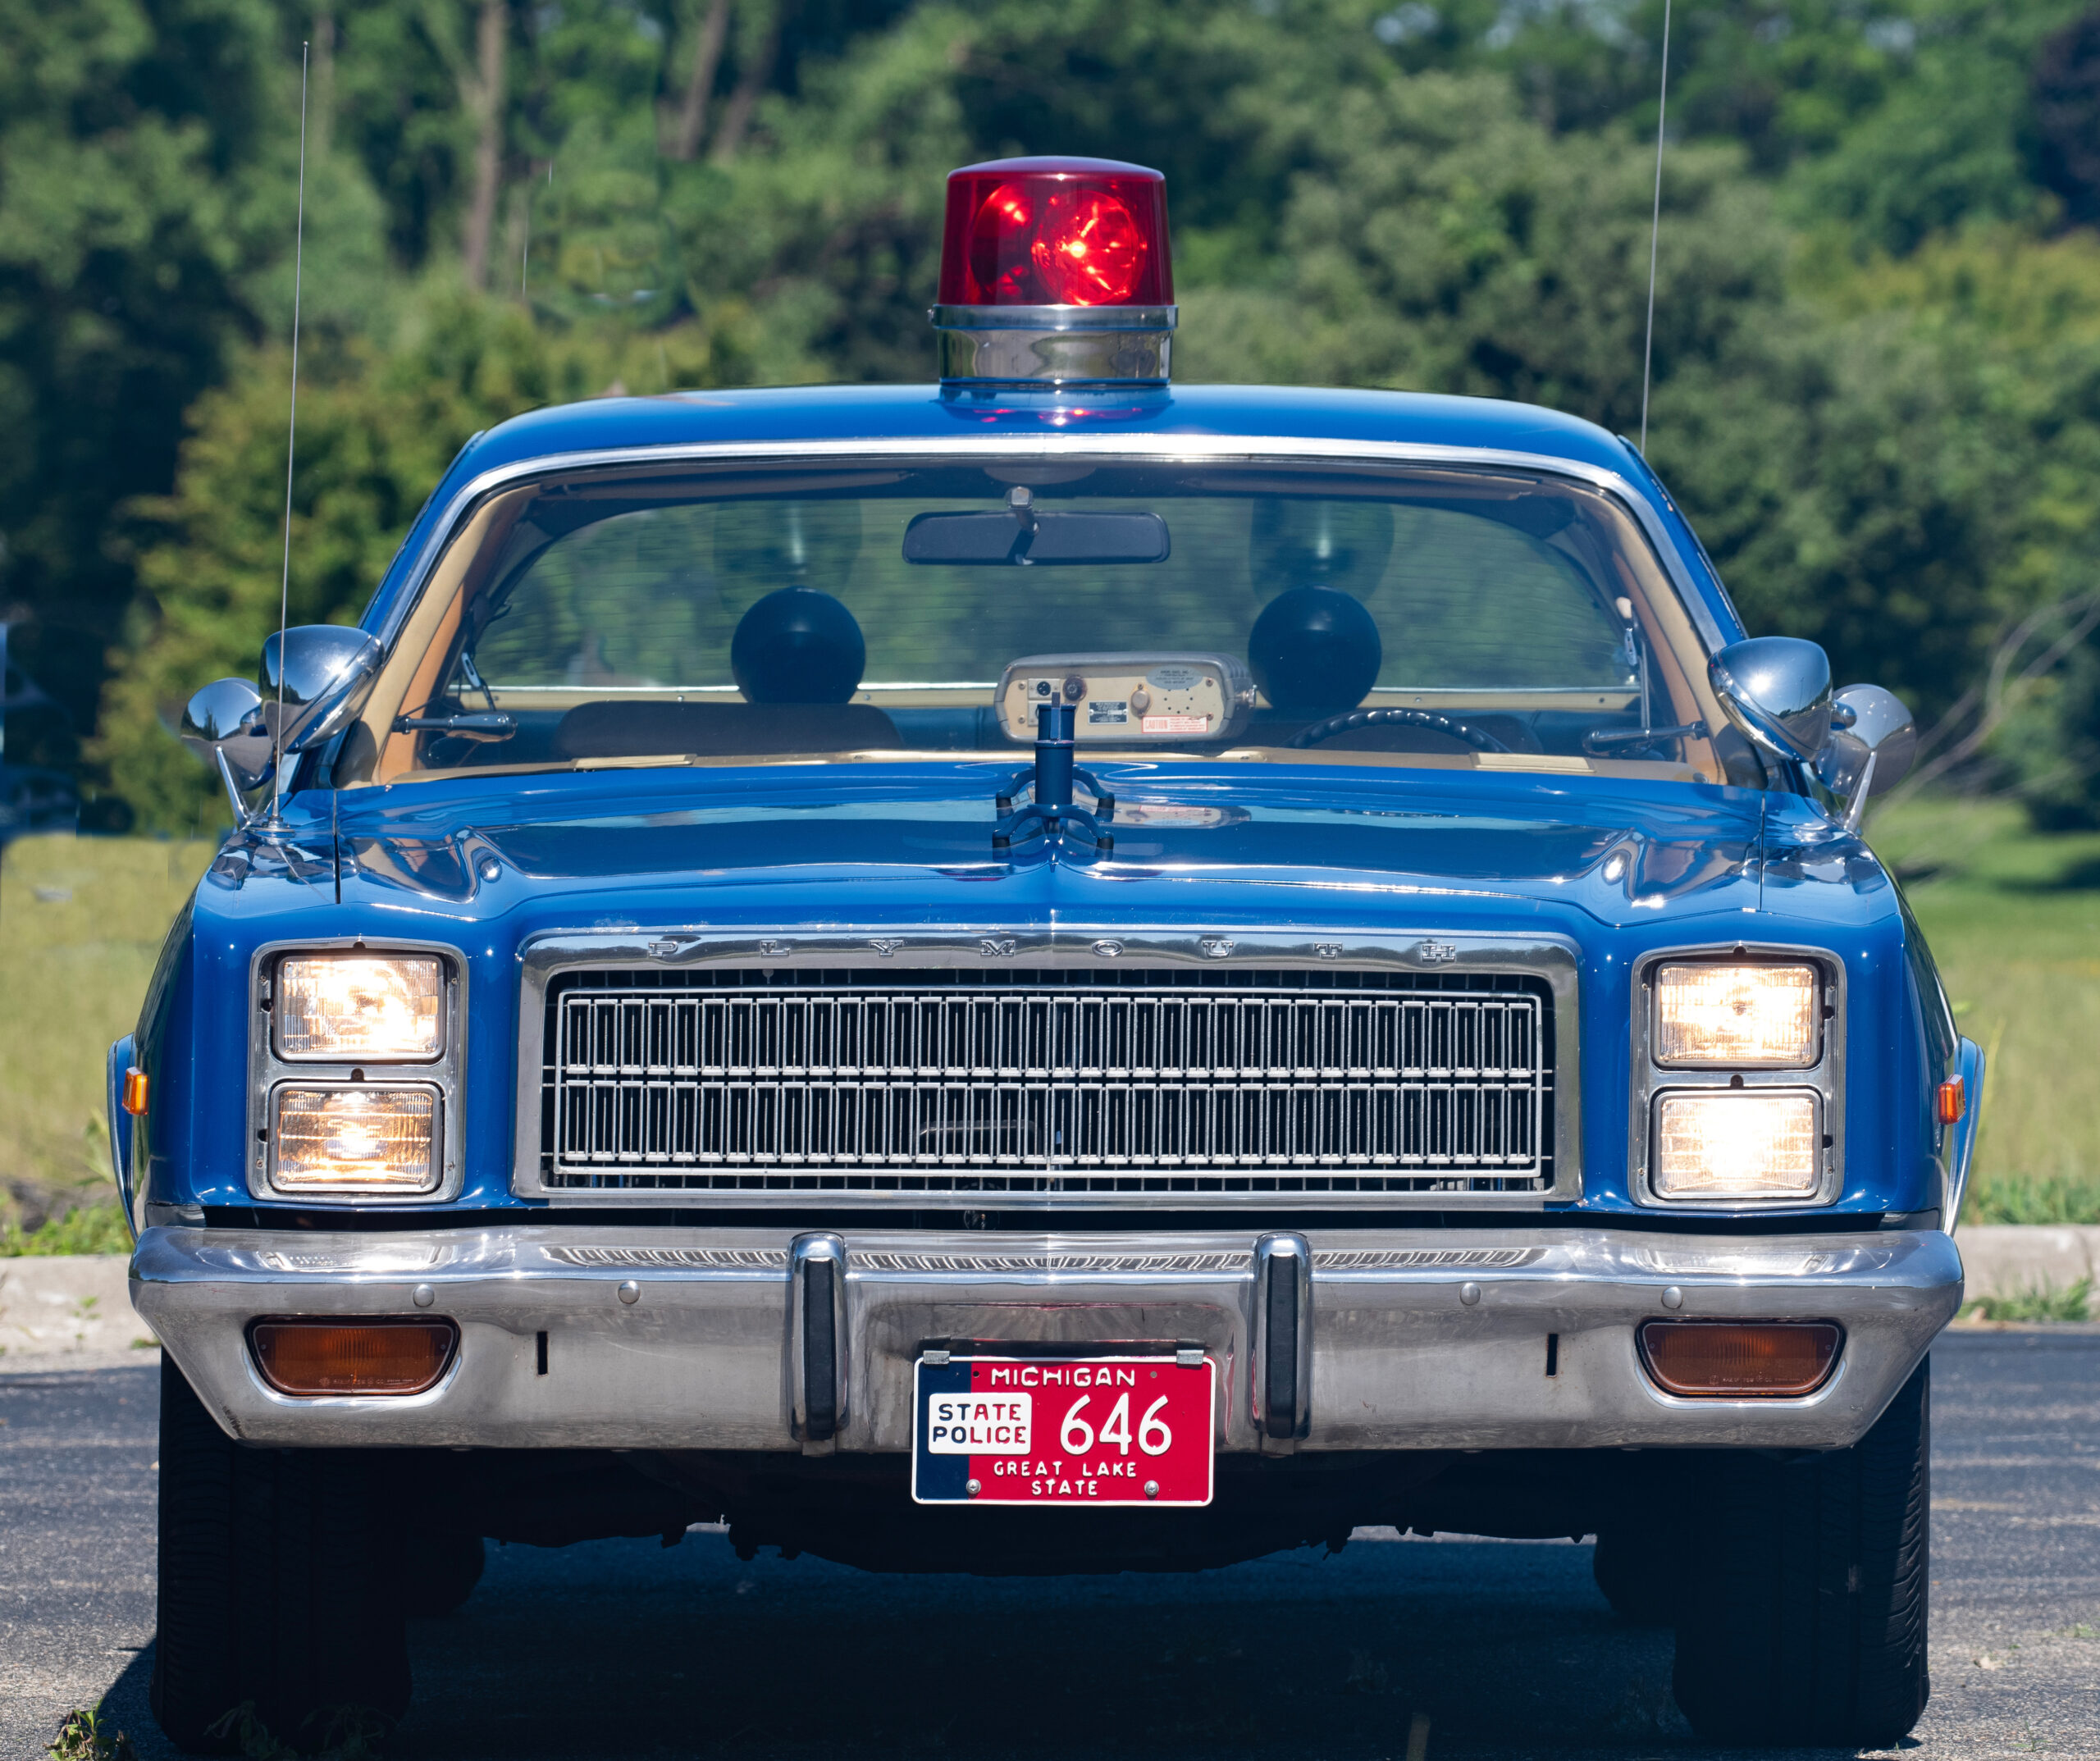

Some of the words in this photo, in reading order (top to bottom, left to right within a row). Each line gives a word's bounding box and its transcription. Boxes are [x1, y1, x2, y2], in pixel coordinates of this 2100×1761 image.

[647, 939, 1456, 962] PLYMOUTH
[990, 1367, 1135, 1388] MICHIGAN
[938, 1403, 1021, 1421] STATE
[1059, 1392, 1172, 1456] 646
[932, 1426, 1026, 1444] POLICE
[993, 1461, 1063, 1476] GREAT
[1081, 1462, 1137, 1477] LAKE
[1031, 1479, 1098, 1496] STATE
